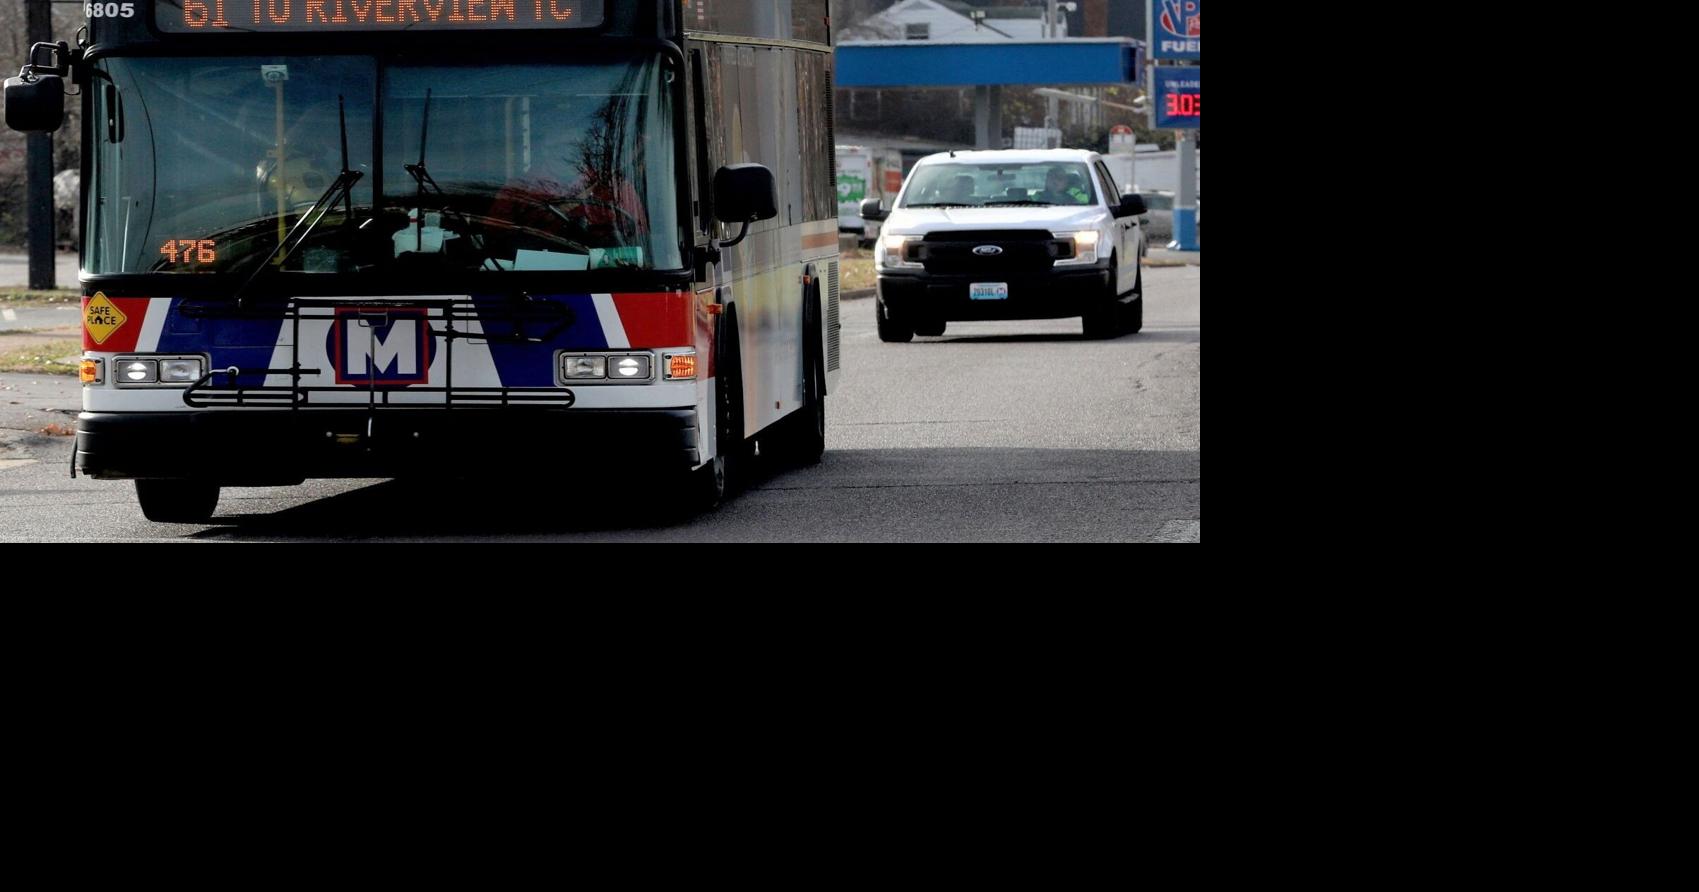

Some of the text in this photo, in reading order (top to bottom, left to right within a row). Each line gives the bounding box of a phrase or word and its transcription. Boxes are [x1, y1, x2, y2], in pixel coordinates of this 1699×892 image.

[85, 2, 135, 18] 6805
[184, 0, 229, 27] 61
[1161, 40, 1200, 52] FUE
[1165, 79, 1200, 89] UNLEADE
[160, 239, 216, 263] 476
[90, 306, 110, 315] SAFE
[346, 318, 417, 375] M
